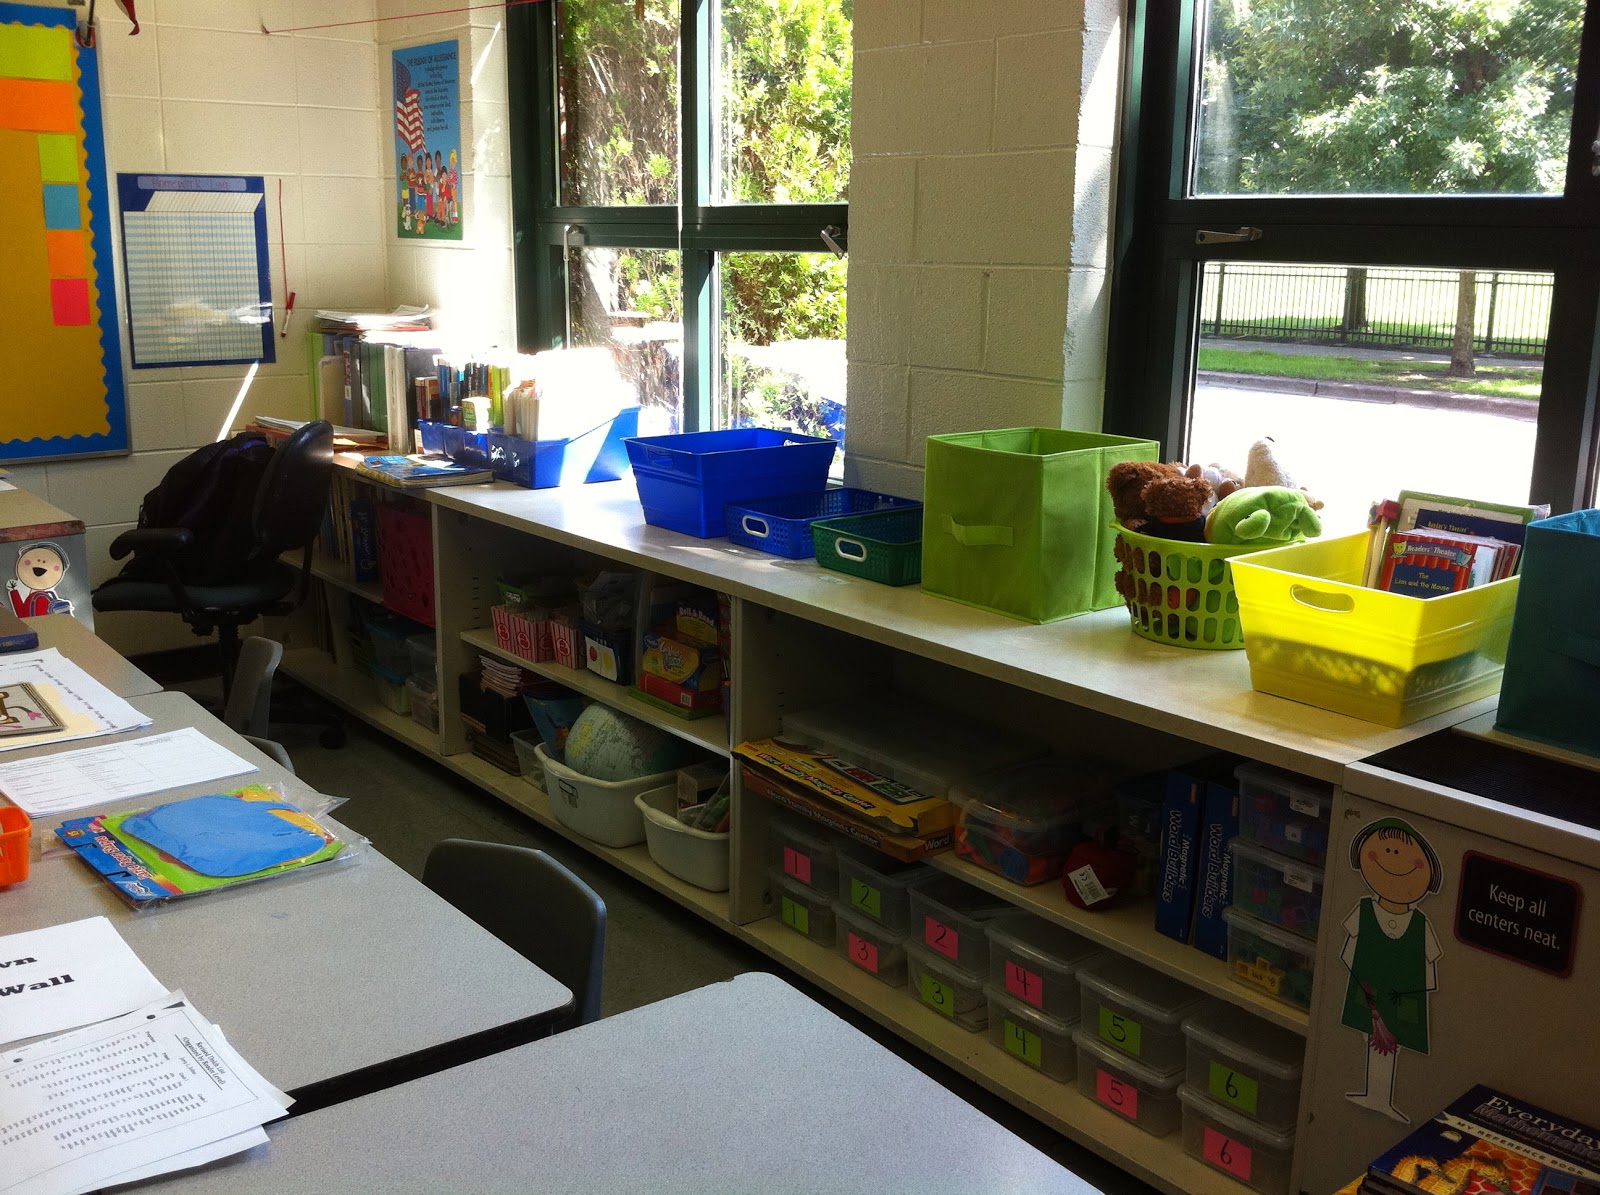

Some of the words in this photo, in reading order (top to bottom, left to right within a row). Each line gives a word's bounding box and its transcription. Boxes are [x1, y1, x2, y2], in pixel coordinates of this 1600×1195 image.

[1434, 547, 1457, 556] Theater
[1418, 572, 1428, 580] The
[924, 835, 950, 850] Word
[1179, 839, 1191, 887] Magnetic
[1219, 852, 1232, 900] Magnetic
[860, 885, 872, 910] 2
[1490, 884, 1525, 912] Keep
[1529, 899, 1547, 918] all
[934, 924, 948, 948] 2
[1468, 908, 1520, 936] centers
[1524, 926, 1560, 950] neat.
[858, 940, 868, 960] 3
[932, 982, 945, 1005] 3
[1015, 966, 1030, 996] 4
[1014, 1026, 1029, 1056] 4
[1108, 1015, 1126, 1042] 5
[1108, 1079, 1124, 1106] 5
[1224, 1072, 1238, 1099] 6
[1472, 1103, 1600, 1163] Mathematic
[1220, 1139, 1232, 1166] 6
[1456, 1120, 1474, 1131] MY
[1477, 1130, 1546, 1162] REFERENCE
[1551, 1159, 1584, 1176] BOOK
